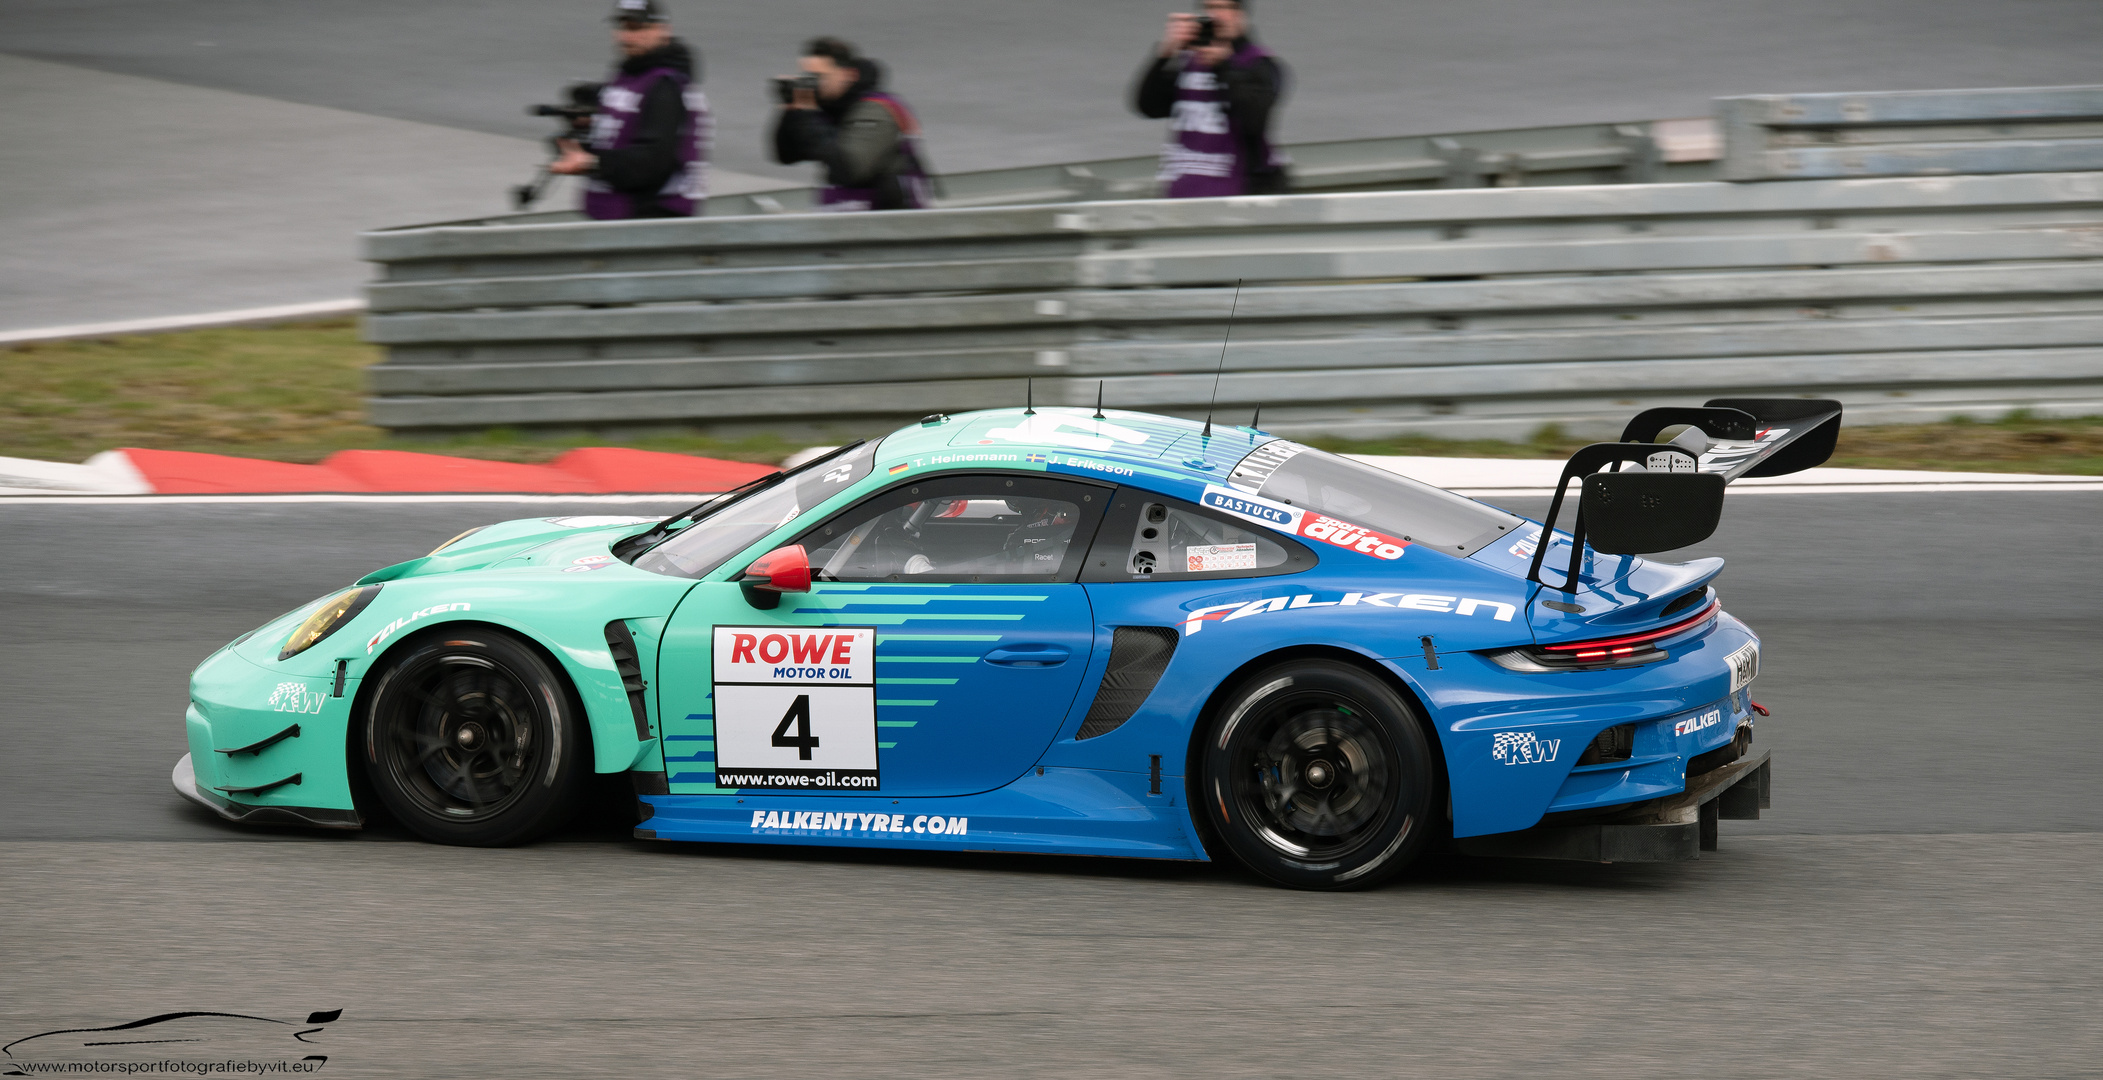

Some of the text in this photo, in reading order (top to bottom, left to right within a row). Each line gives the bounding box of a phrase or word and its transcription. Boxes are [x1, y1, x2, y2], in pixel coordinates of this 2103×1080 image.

[914, 453, 1018, 468] T. Heinemann
[1048, 455, 1134, 477] J. Eriksson
[1214, 496, 1284, 522] BASTUCK
[1316, 516, 1372, 536] sport
[1304, 523, 1405, 560] auto
[1175, 592, 1517, 637] FALKEN
[365, 602, 471, 655] FALKEN
[731, 633, 855, 665] ROWE
[773, 667, 852, 679] MOTOR OIL
[274, 690, 326, 715] KW
[771, 694, 819, 761] 4
[1674, 709, 1721, 737] FALKEN
[1505, 739, 1561, 765] KW
[719, 772, 877, 787] www.rowe-oil.com
[751, 810, 968, 836] FALKENTYRE.COM
